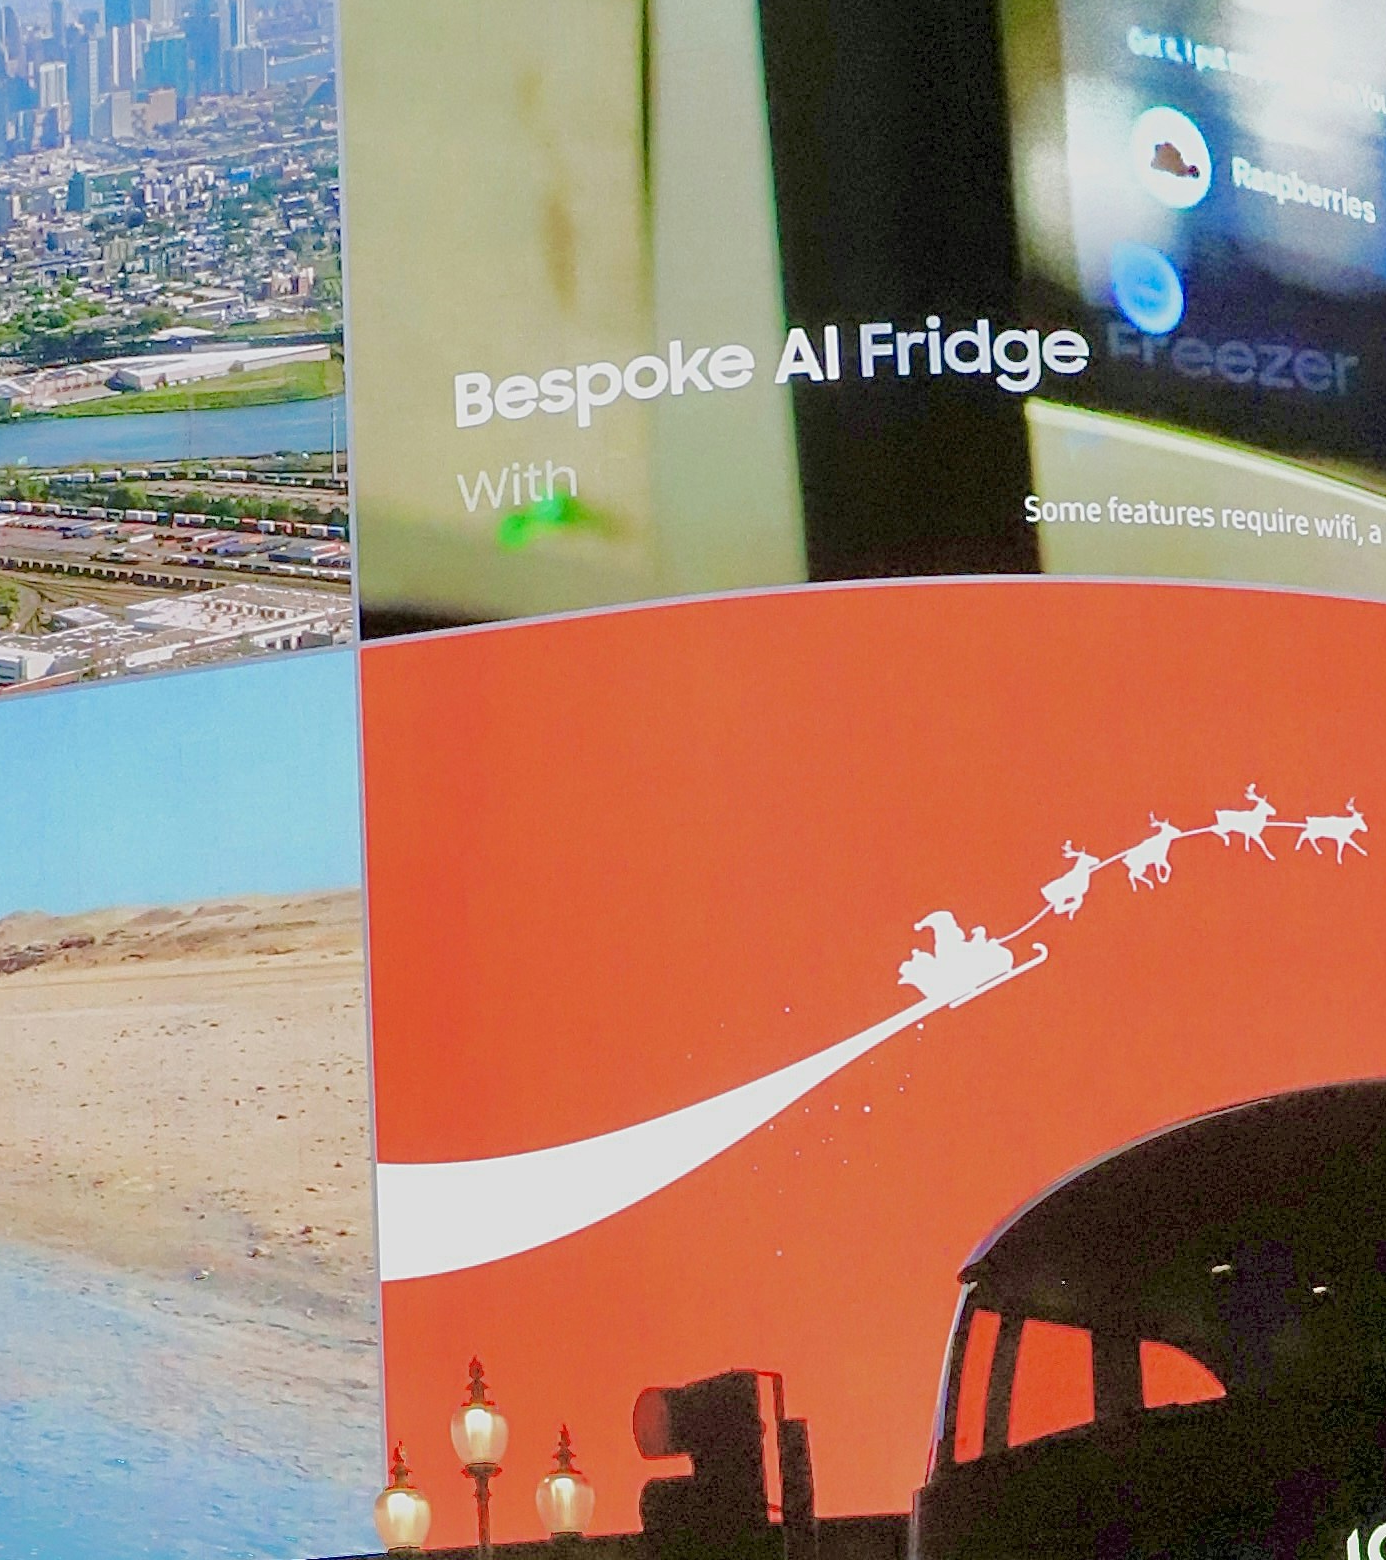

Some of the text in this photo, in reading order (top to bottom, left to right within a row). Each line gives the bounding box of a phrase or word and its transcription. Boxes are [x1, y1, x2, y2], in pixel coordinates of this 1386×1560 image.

[1231, 155, 1377, 223] Raspberries
[454, 315, 1360, 428] Bespoke AI Fridge Freezer
[457, 458, 578, 513] With
[1024, 496, 1101, 524] Some
[1107, 496, 1214, 528] features
[1221, 504, 1310, 538] require
[1314, 513, 1363, 547] wifi,
[1368, 522, 1382, 545] a
